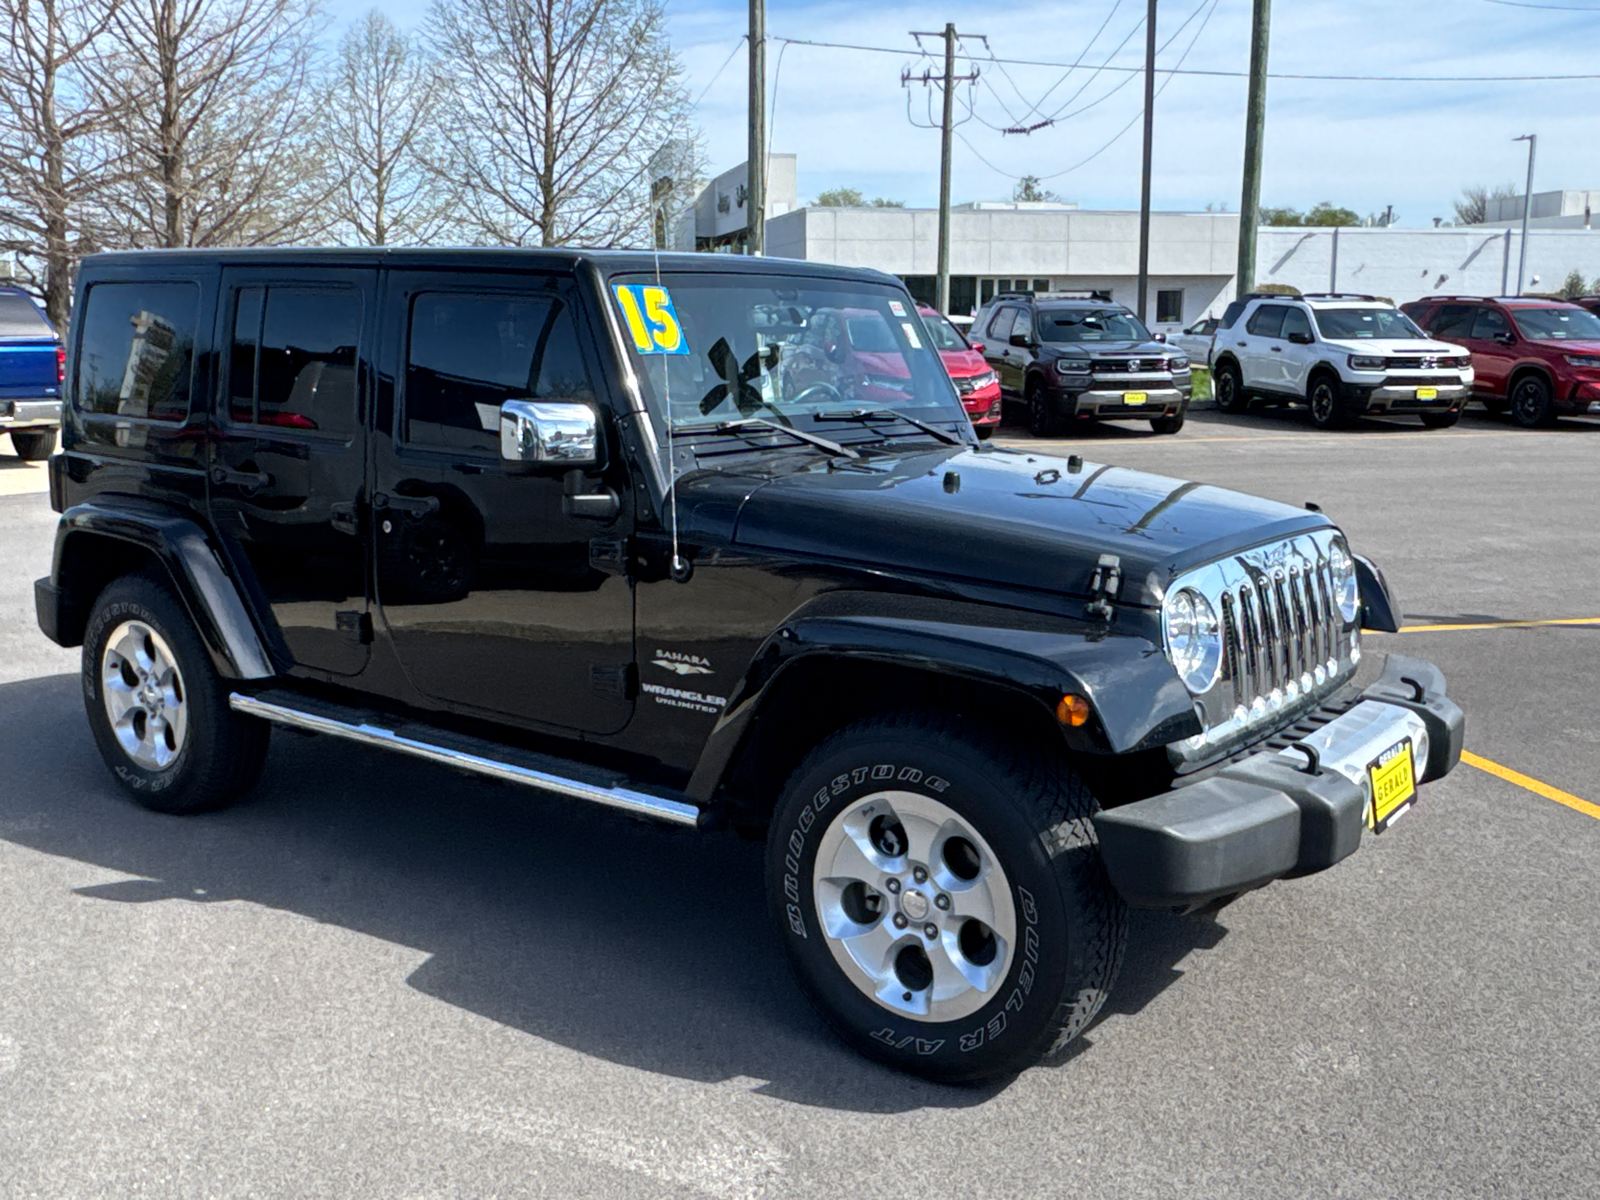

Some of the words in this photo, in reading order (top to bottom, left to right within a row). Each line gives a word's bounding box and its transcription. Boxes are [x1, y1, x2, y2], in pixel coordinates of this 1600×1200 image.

[617, 285, 681, 351] 15
[656, 649, 710, 666] SAHARA
[642, 683, 726, 706] WRANGLER
[655, 697, 717, 713] UNLIMITED
[1378, 767, 1408, 801] GERALD
[784, 764, 950, 939] BRIDGESTONE
[959, 885, 1039, 1052] DUELER
[870, 1027, 946, 1056] A/T
